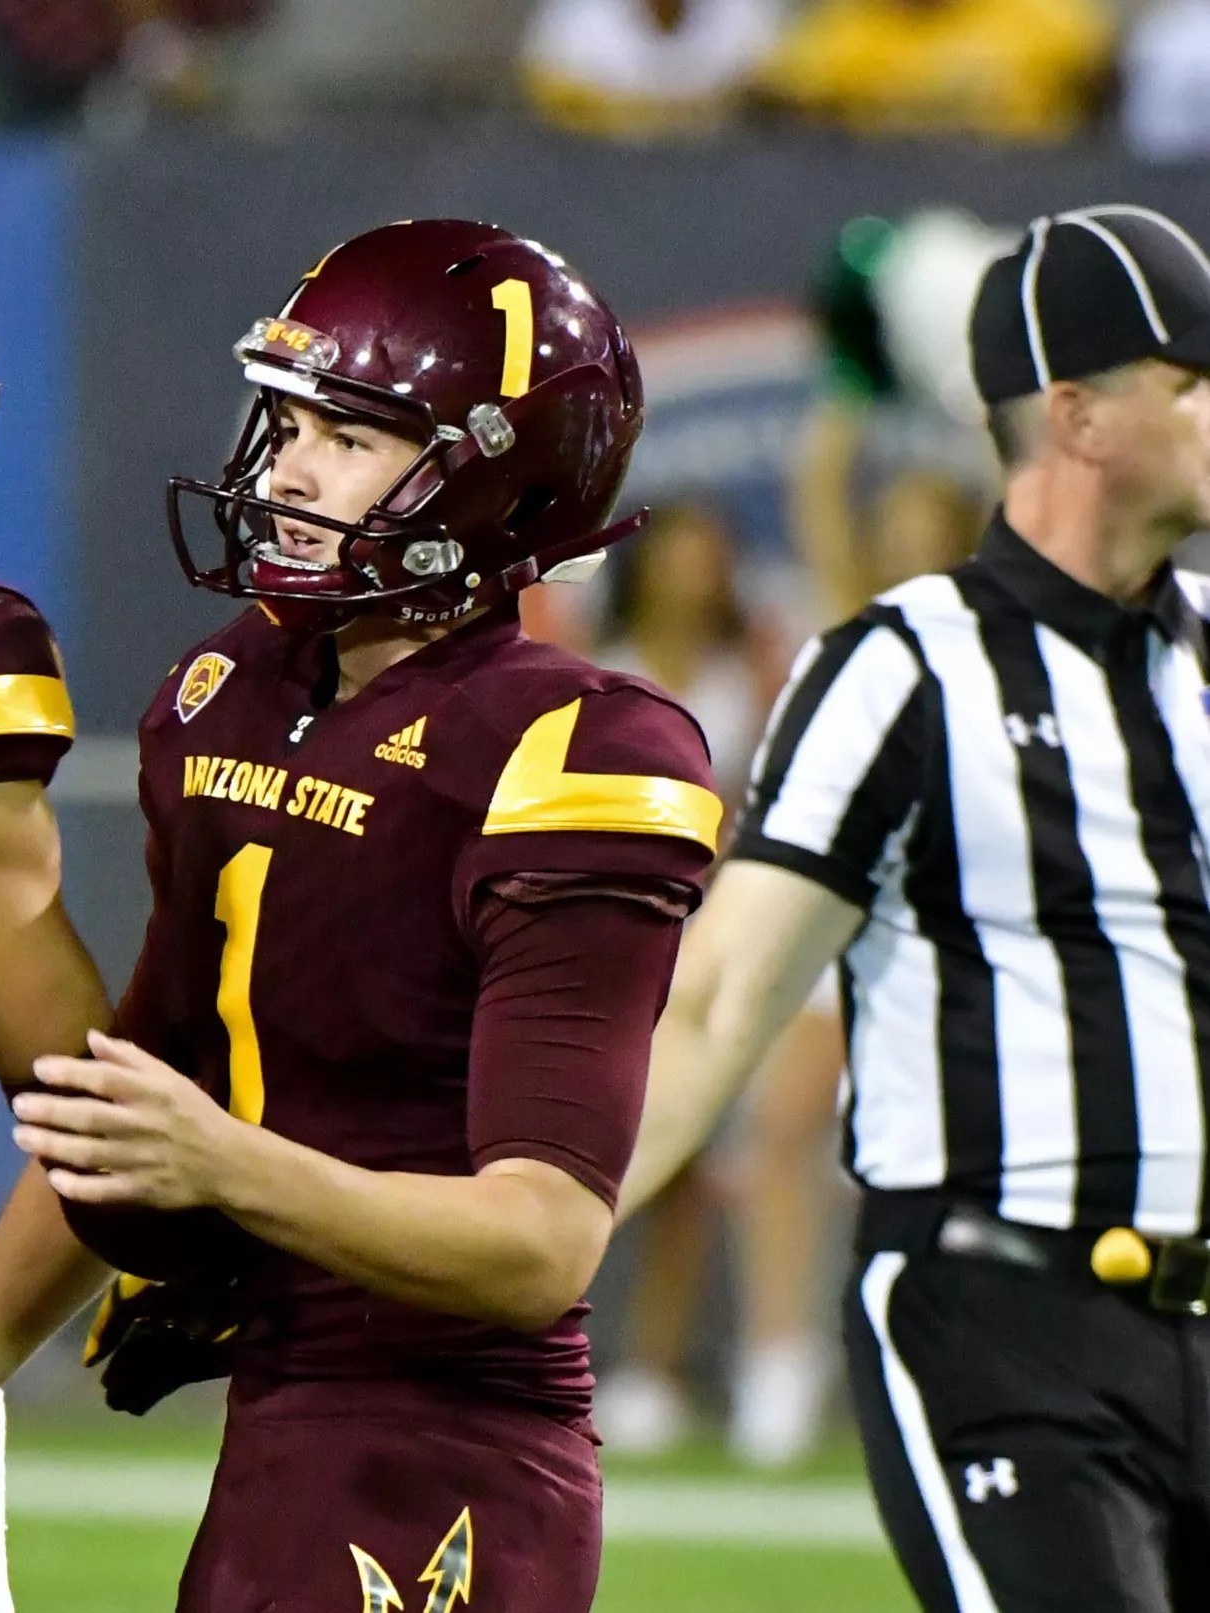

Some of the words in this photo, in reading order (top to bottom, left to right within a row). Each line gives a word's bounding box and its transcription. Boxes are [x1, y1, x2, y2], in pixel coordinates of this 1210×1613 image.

[491, 278, 533, 398] 1
[400, 604, 462, 622] SPORT
[374, 740, 427, 769] adidas
[183, 756, 289, 811] ARIZONA
[286, 776, 375, 836] STATE
[214, 842, 273, 1126] 1
